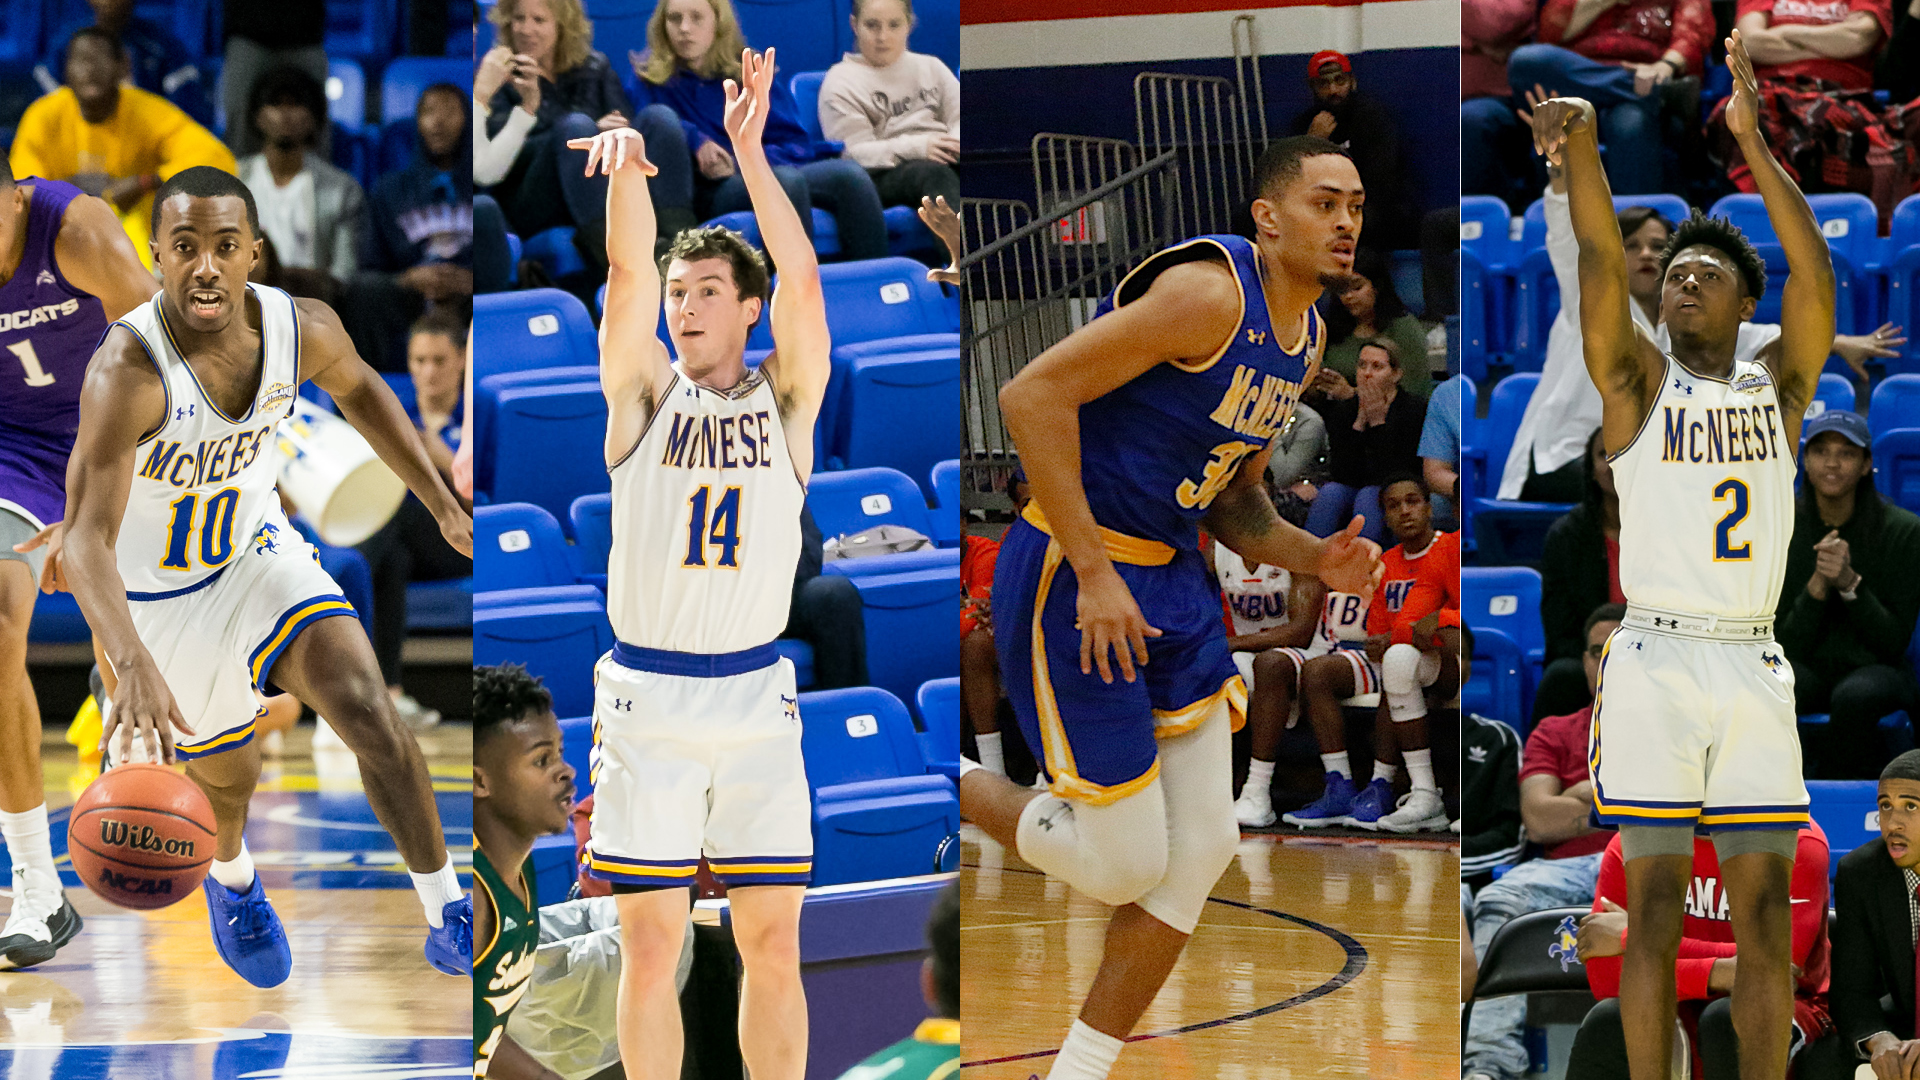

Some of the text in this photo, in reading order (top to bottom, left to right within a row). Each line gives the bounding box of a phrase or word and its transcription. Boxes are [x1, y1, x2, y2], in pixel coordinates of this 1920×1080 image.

[6, 339, 56, 387] 1
[158, 486, 242, 572] 10
[681, 483, 744, 571] 14
[1711, 476, 1753, 562] 2
[1228, 591, 1286, 621] HBU
[100, 817, 196, 858] Wilson
[100, 867, 173, 896] NCAA
